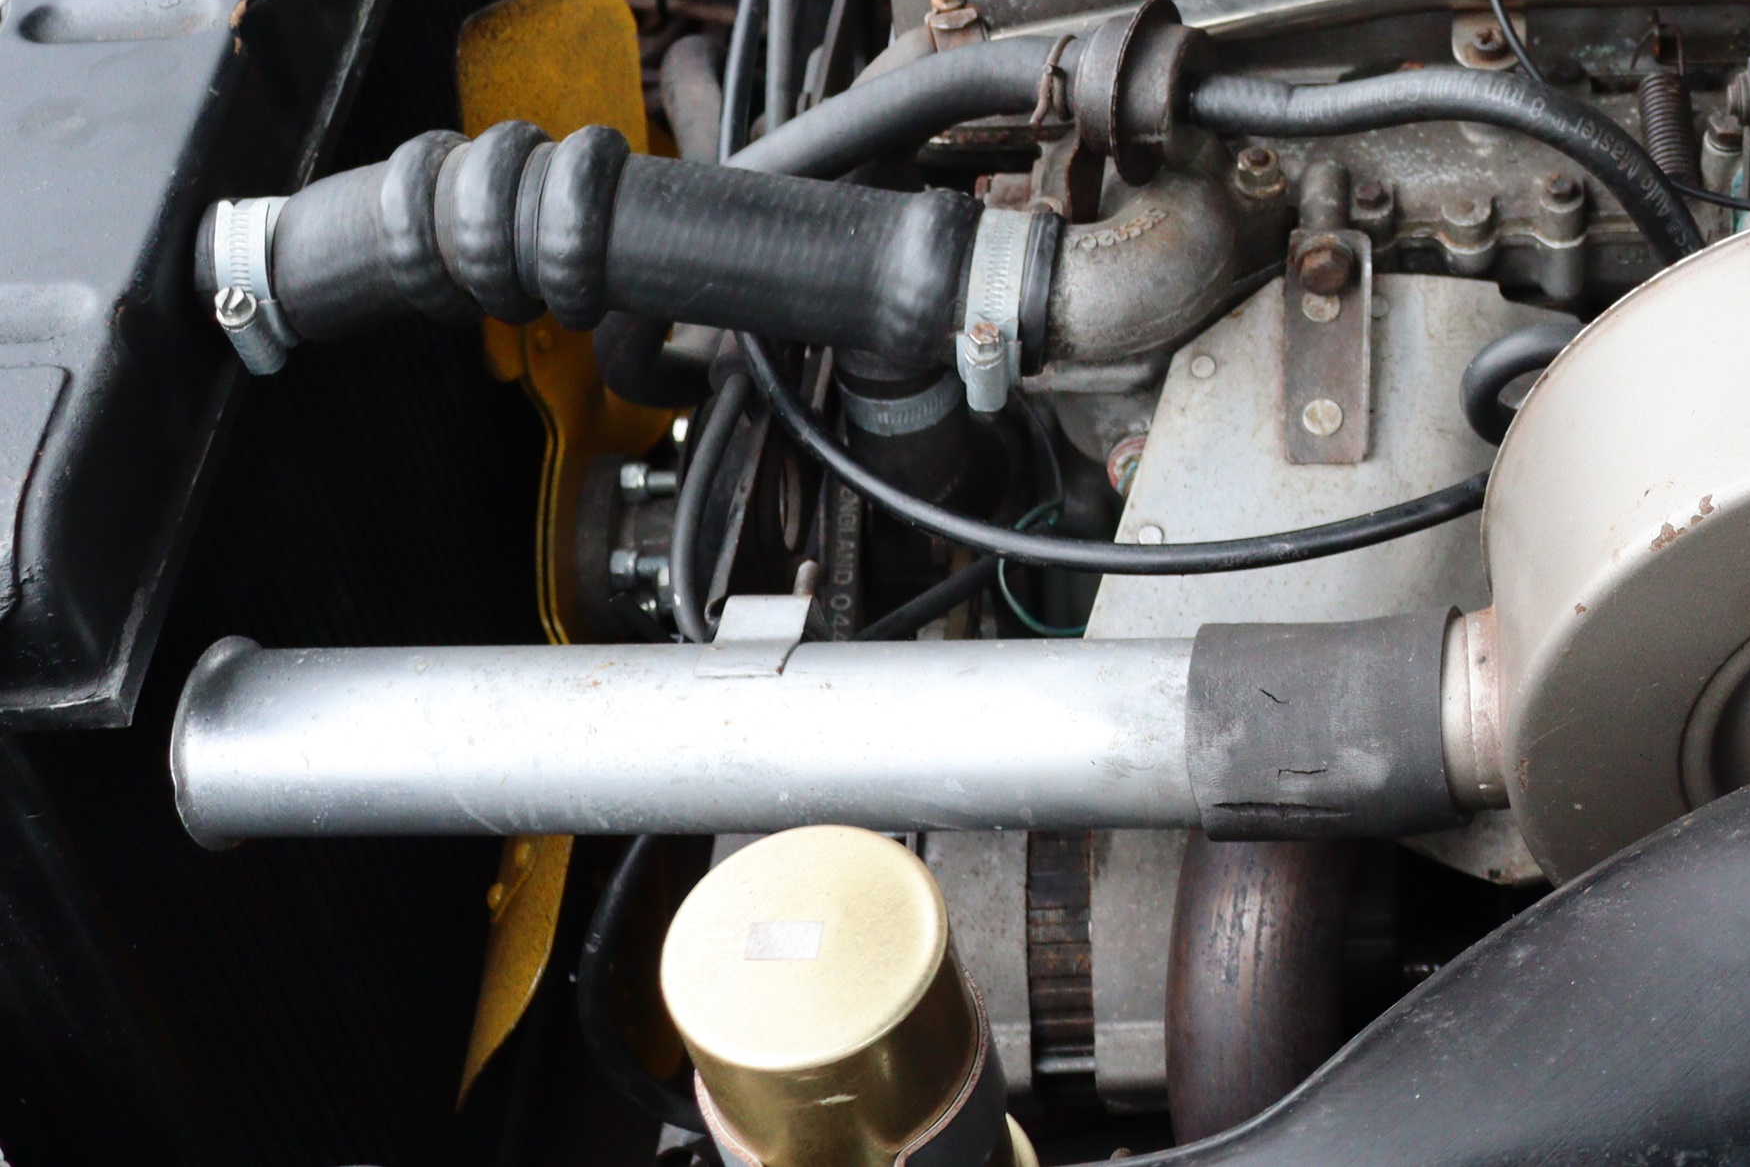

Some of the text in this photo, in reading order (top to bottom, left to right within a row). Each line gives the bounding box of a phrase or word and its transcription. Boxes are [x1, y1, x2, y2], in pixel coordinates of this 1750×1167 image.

[1484, 83, 1525, 107] mm
[1527, 96, 1546, 118] 8
[1640, 172, 1675, 217] Auto
[836, 487, 859, 585] ENGLAND
